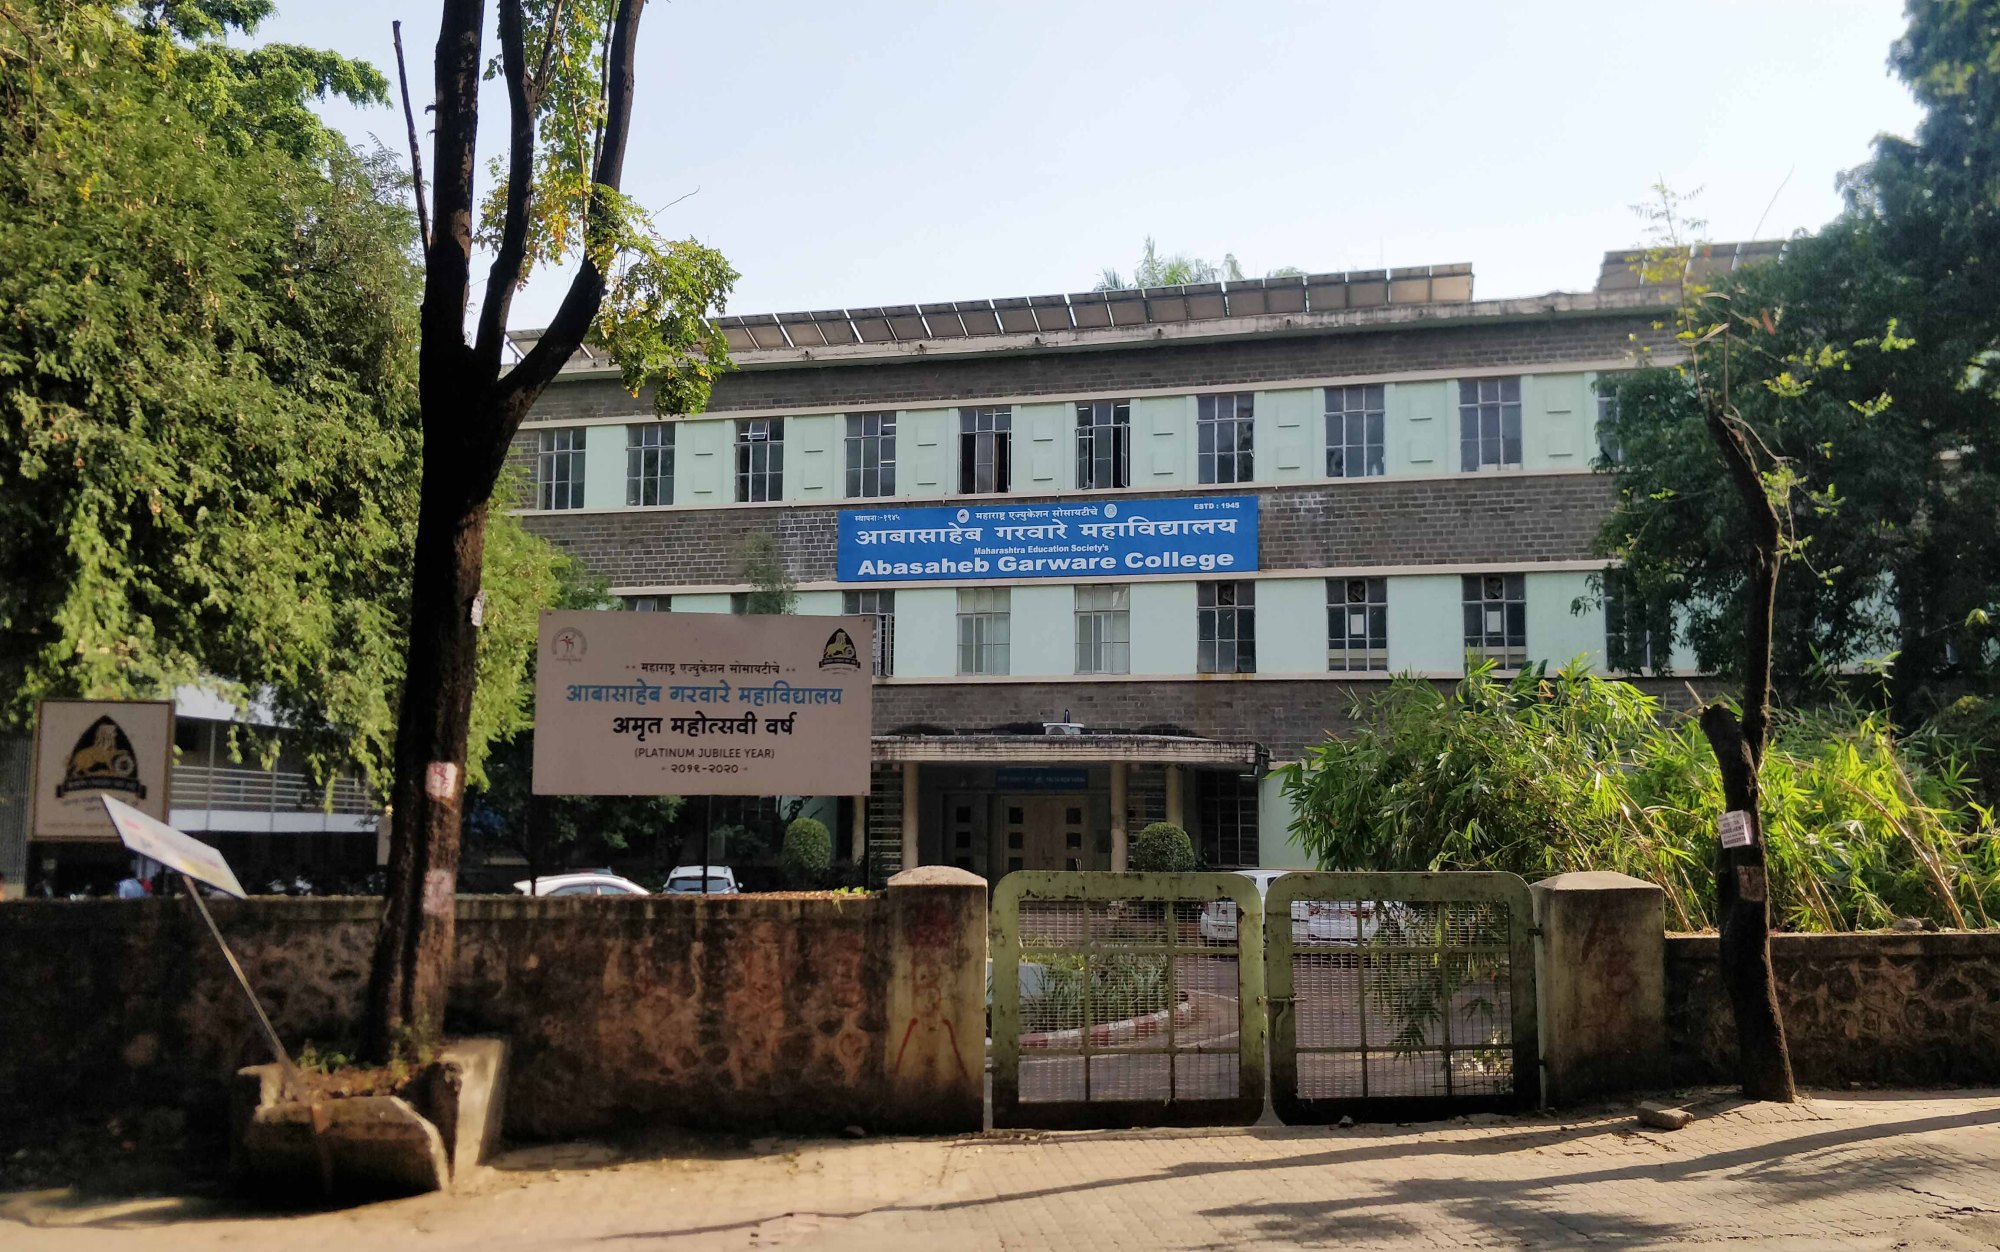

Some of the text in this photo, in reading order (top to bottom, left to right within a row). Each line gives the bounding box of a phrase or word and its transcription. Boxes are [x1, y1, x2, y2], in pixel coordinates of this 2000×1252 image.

[975, 506, 1098, 522] महाराष्ट्र एज्युकेशन सोसायटीचे
[855, 515, 1239, 545] आबासाहेब गरवारे महाविद्यालय
[974, 544, 1109, 556] Maharashtra Education Society's
[857, 551, 1235, 576] Abasaheb Garware College
[641, 659, 780, 677] महाराष्ट्र एज्युकेशन सोसायटीचे
[566, 678, 843, 707] आबासाहेब गरवारे महाविद्यालय
[612, 710, 798, 742] अमृत महोत्सवी वर्ष
[634, 747, 775, 759] (PLATINUM JUBILEE YEAR)
